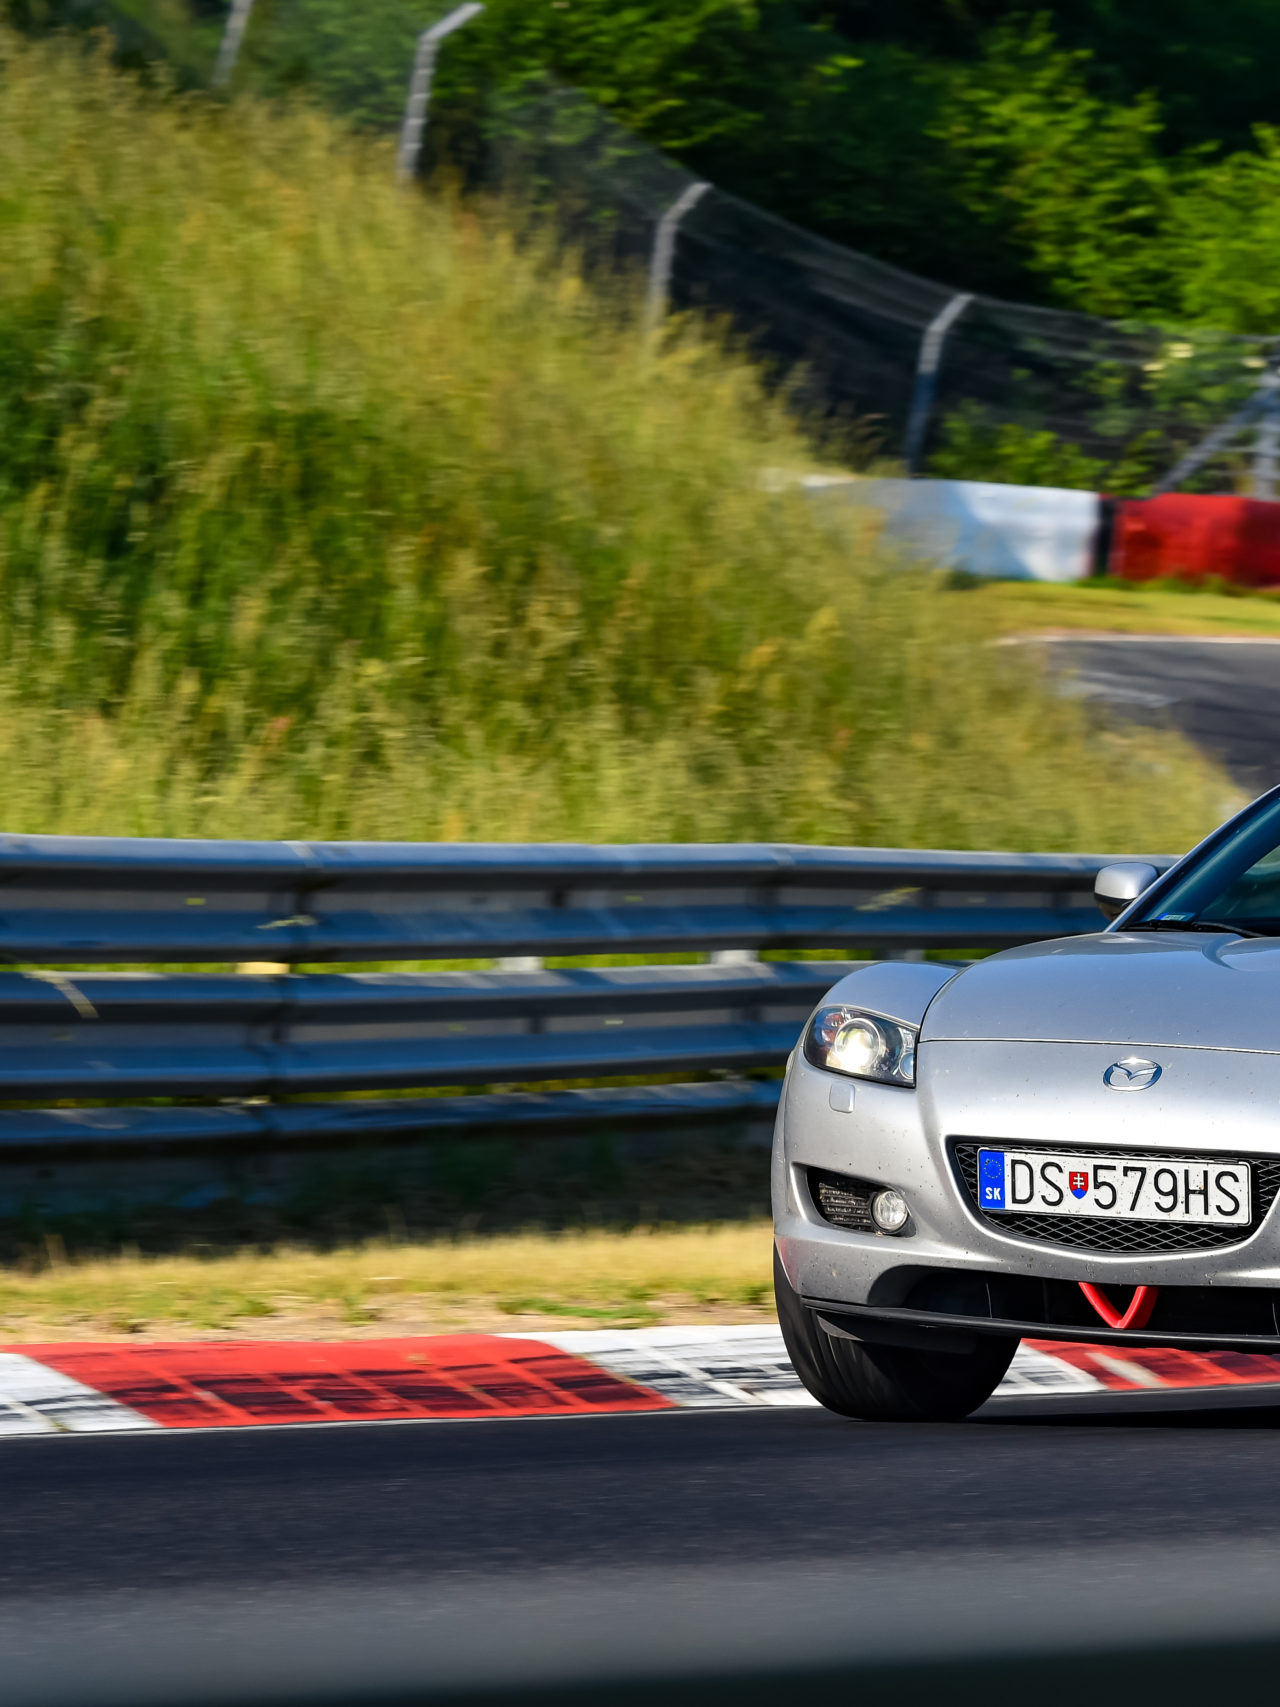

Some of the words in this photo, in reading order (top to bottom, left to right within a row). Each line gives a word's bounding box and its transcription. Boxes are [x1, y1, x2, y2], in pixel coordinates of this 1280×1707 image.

[985, 1187, 1001, 1200] SK
[1011, 1159, 1064, 1207] DS
[1092, 1164, 1240, 1216] 579HS
